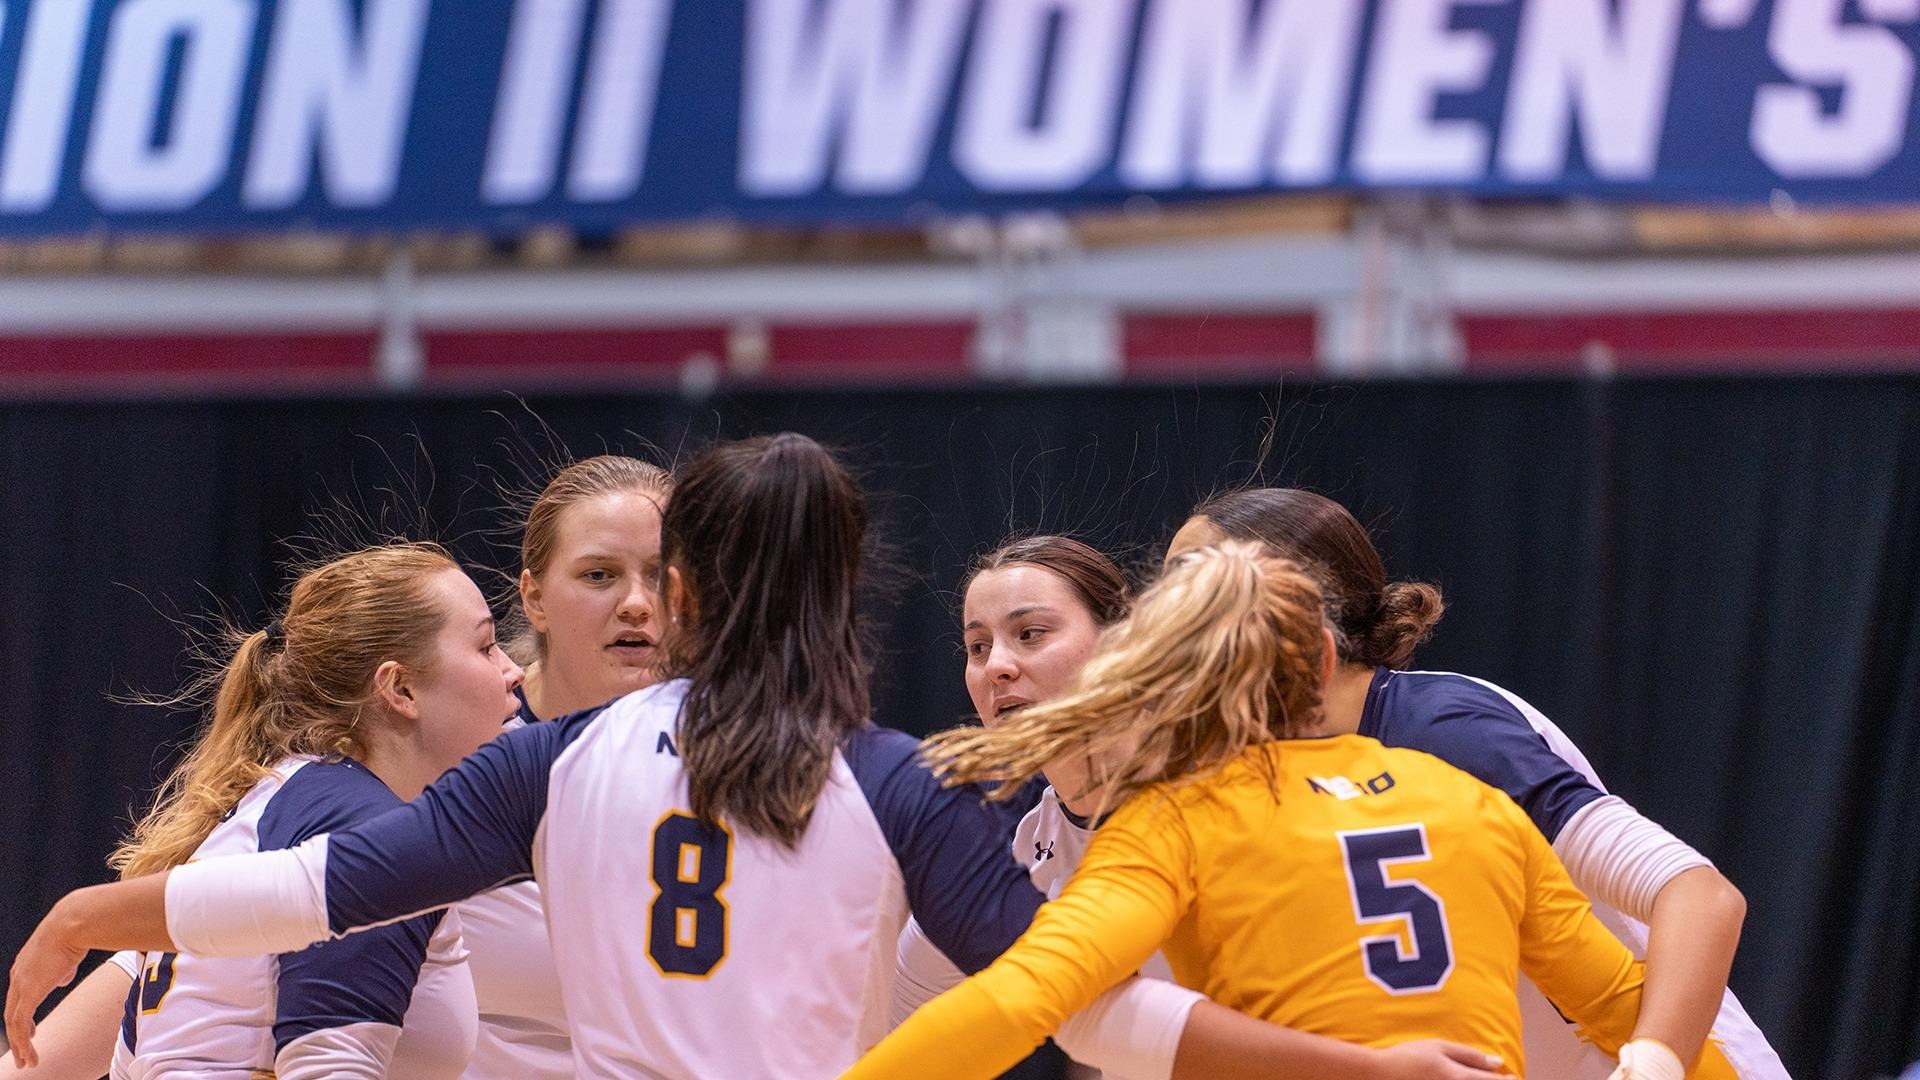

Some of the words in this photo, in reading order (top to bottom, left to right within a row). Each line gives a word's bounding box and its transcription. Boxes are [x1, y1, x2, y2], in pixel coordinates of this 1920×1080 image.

[481, 0, 676, 204] II
[644, 808, 734, 980] 8
[1335, 822, 1455, 996] 5
